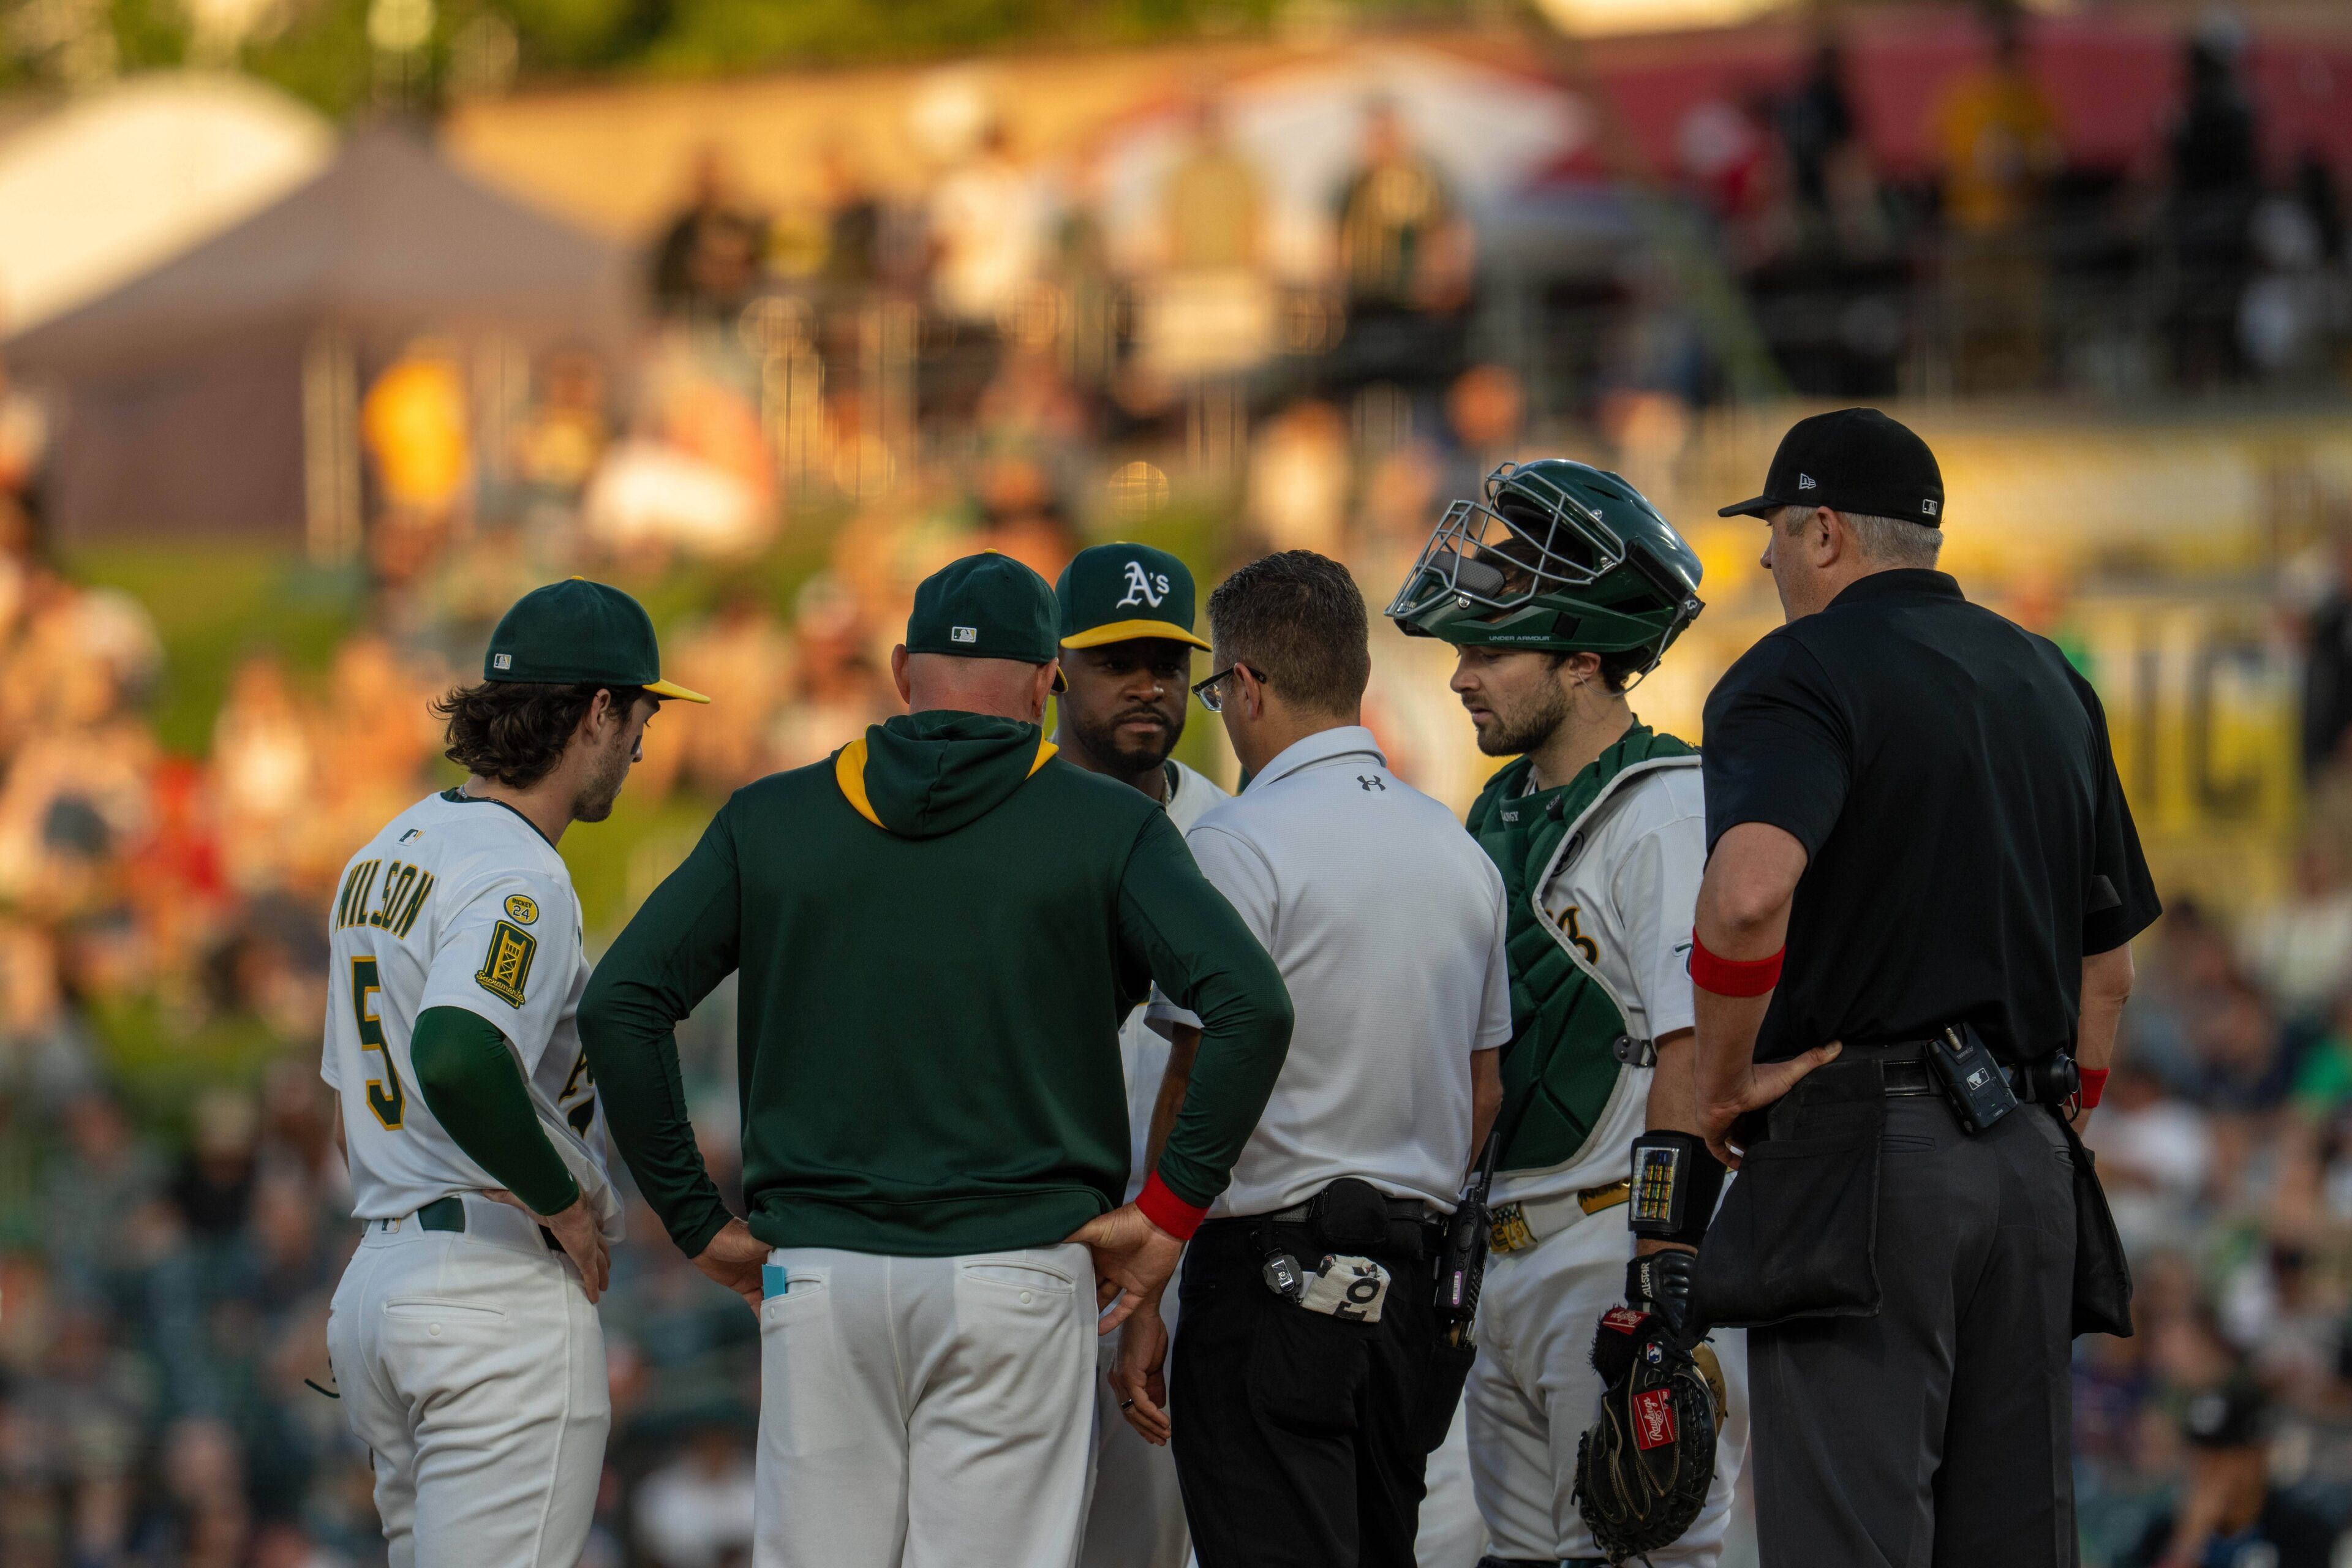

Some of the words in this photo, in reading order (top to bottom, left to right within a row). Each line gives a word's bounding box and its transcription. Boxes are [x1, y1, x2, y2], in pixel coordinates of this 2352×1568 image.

[1116, 560, 1170, 609] A's
[334, 859, 435, 941] WILSON
[512, 897, 532, 909] RICKEY
[512, 905, 530, 921] 24
[476, 971, 525, 1003] Sacramento
[350, 956, 405, 1131] 5
[1643, 1396, 1664, 1441] Rawlings
